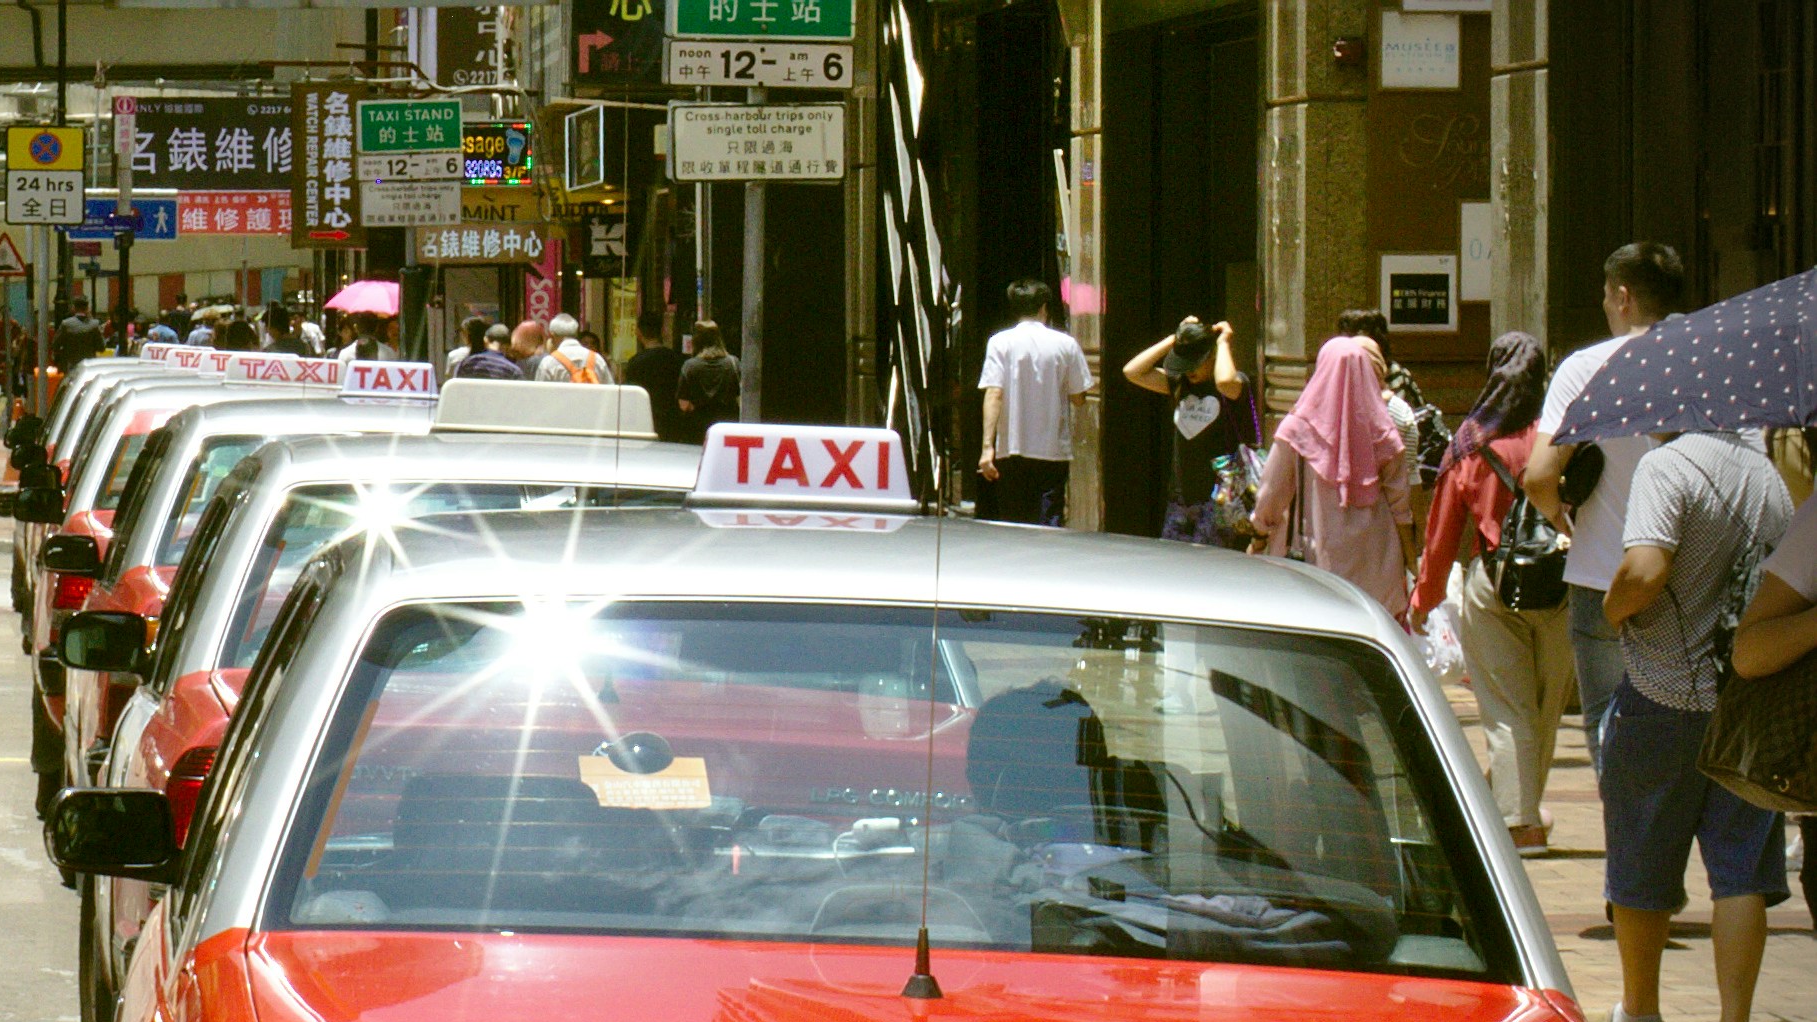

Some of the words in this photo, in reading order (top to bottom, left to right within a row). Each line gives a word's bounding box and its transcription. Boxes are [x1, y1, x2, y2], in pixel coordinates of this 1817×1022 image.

[709, 0, 821, 23] 的士站
[679, 49, 712, 58] noon
[789, 53, 809, 61] am
[822, 52, 843, 81] 6
[679, 65, 711, 80] 中午
[783, 67, 815, 82] 上午
[306, 92, 319, 133] WATCH
[368, 111, 400, 122] TAXI
[405, 109, 455, 121] STAND
[776, 111, 804, 123] trips
[807, 110, 833, 123] only
[378, 124, 445, 144] 的士站
[707, 123, 743, 135] single
[747, 124, 767, 134] toll
[771, 123, 813, 135] charge
[306, 135, 319, 178] REPAIR
[446, 157, 458, 174] 6
[16, 177, 41, 192] 24
[46, 177, 74, 193] hrs
[22, 198, 66, 218] 全日
[421, 229, 543, 258] 名錶維修中心
[239, 358, 339, 384] TAXI
[354, 365, 430, 391] TAXI
[723, 435, 890, 490] TAXI
